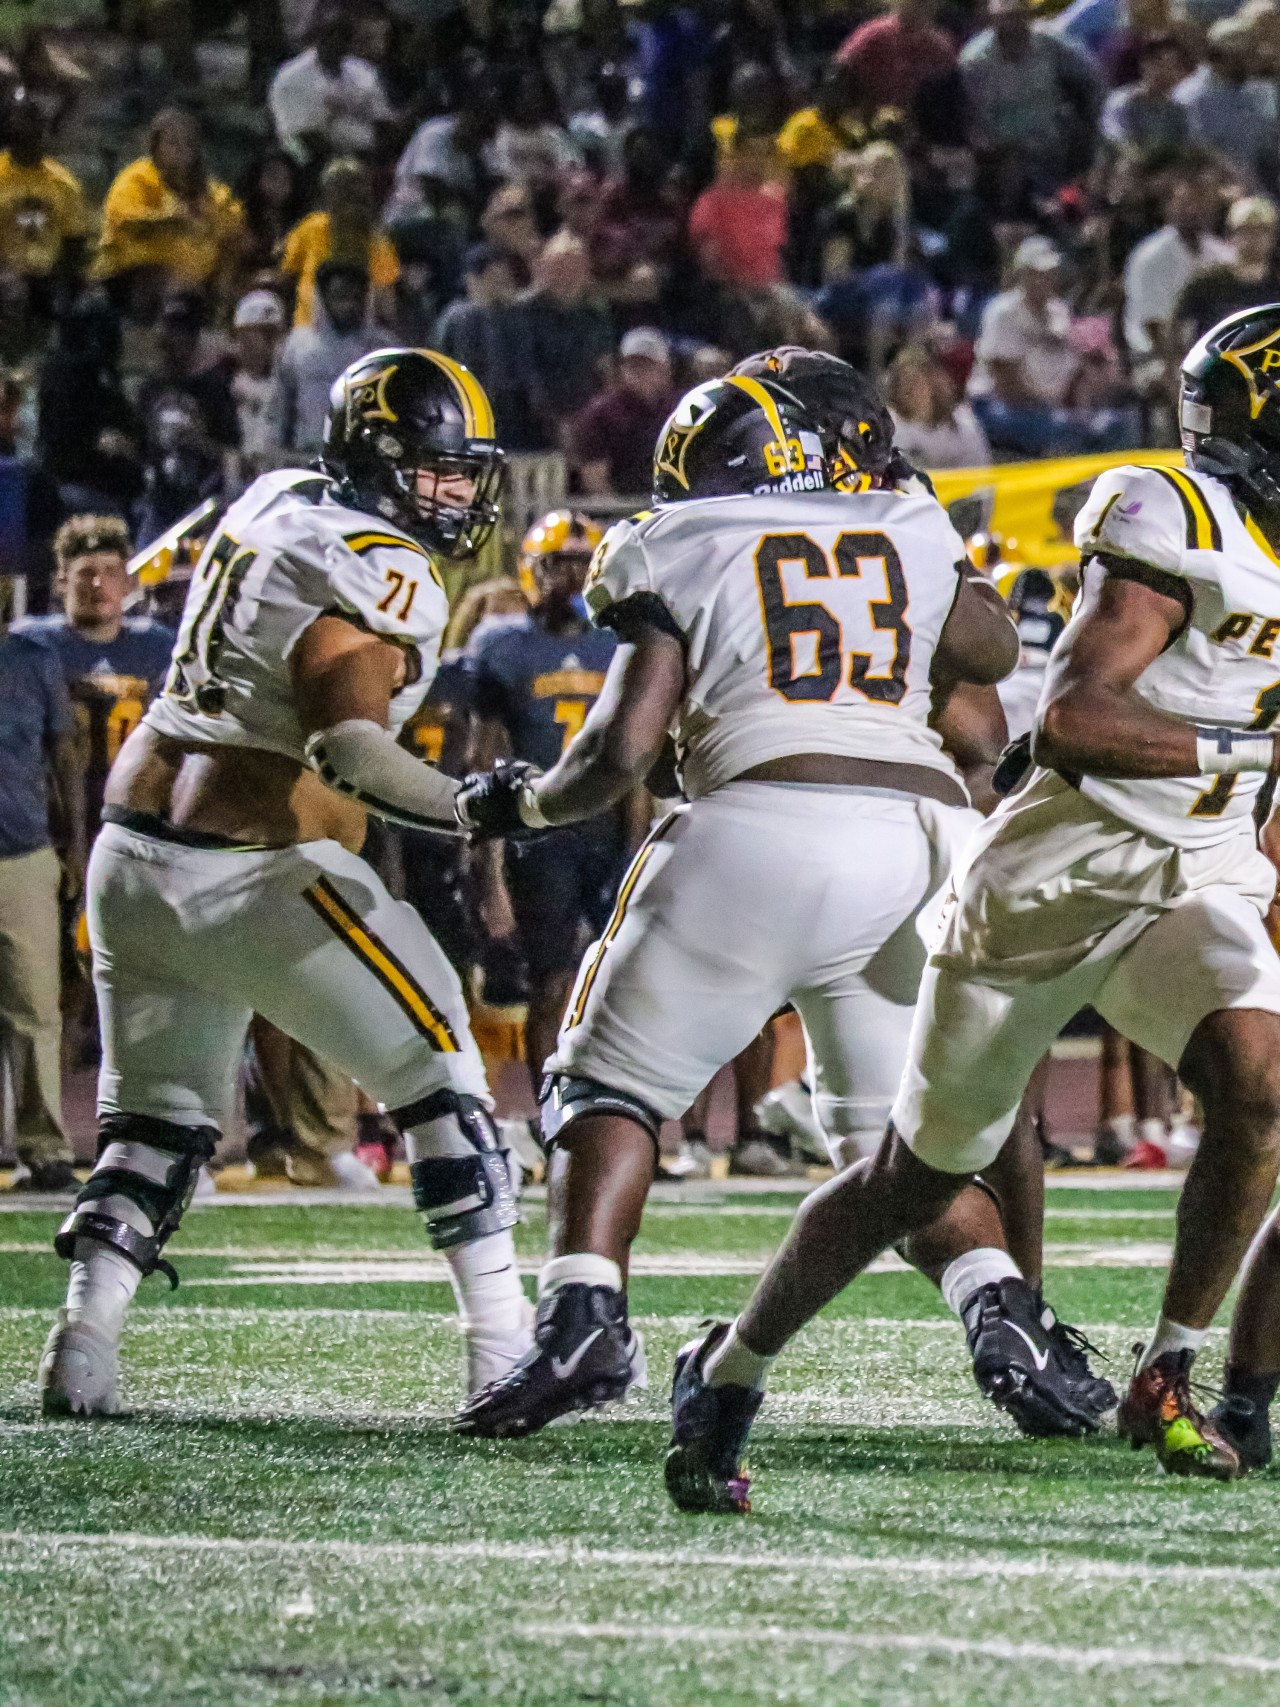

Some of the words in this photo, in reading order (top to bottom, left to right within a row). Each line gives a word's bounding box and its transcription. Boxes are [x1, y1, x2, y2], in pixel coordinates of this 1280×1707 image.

[763, 438, 806, 477] 63
[376, 568, 419, 622] 71
[754, 531, 912, 707] 63
